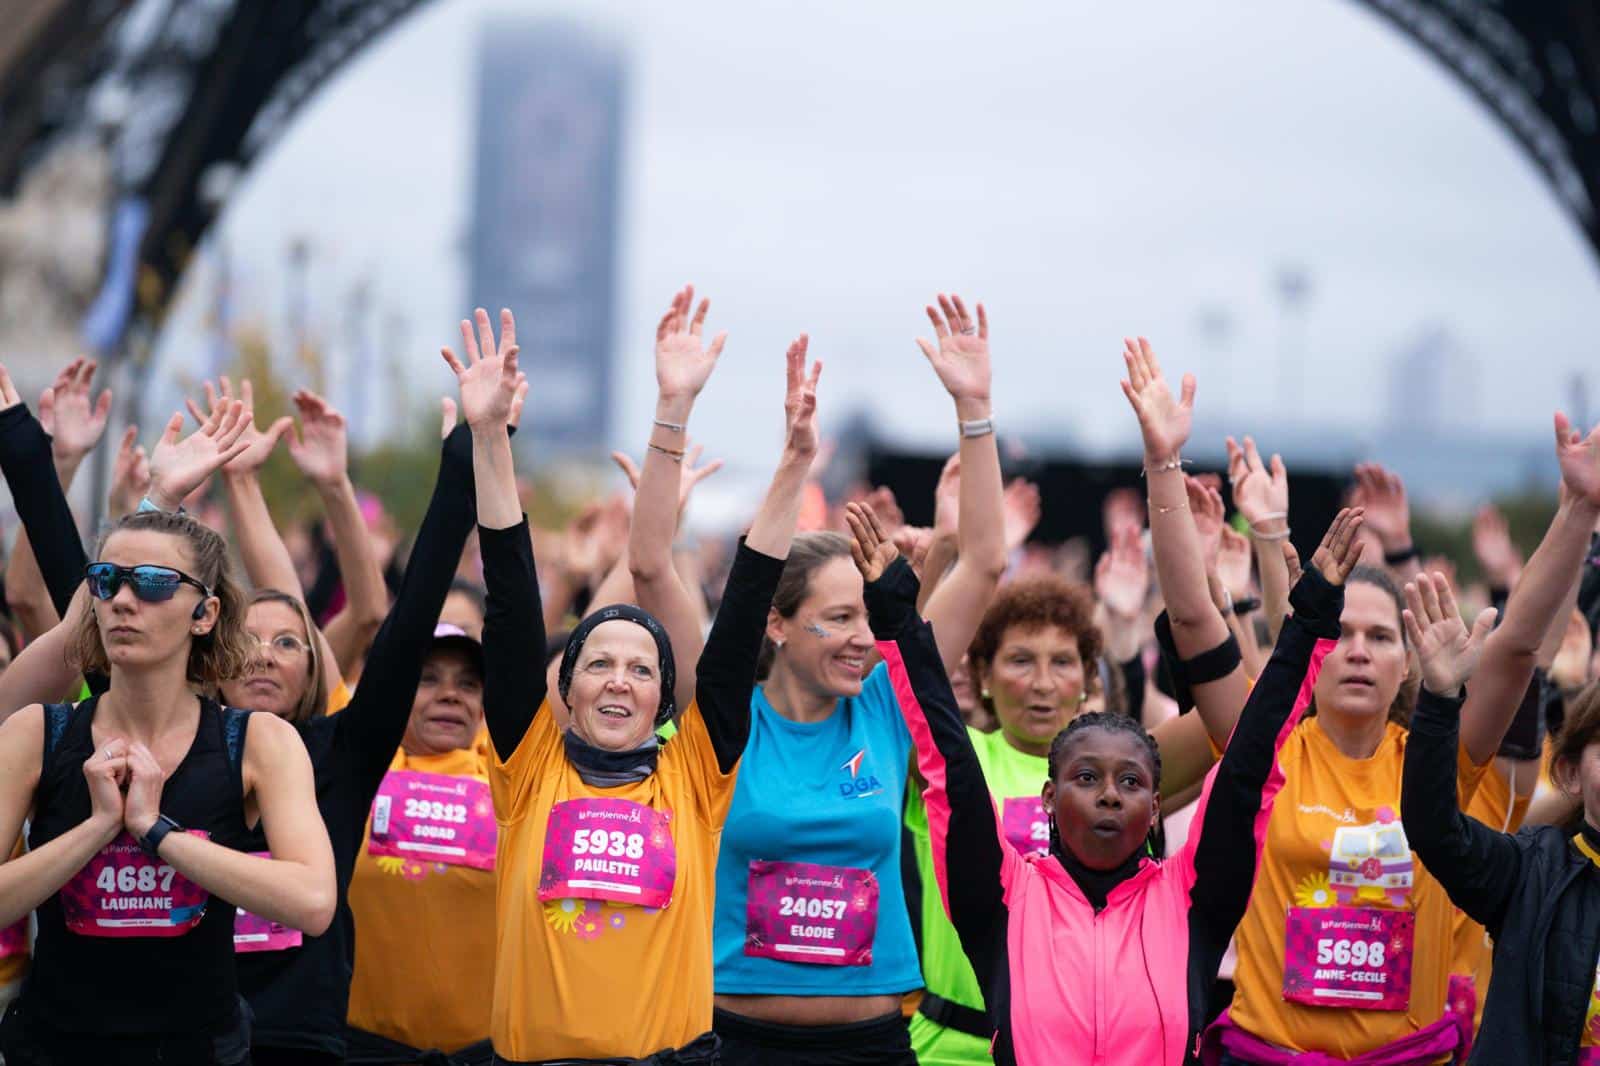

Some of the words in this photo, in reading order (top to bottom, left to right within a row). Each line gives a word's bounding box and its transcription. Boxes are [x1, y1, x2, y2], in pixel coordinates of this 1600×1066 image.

[840, 776, 882, 796] DGA
[404, 798, 467, 824] 29312
[413, 824, 456, 840] SOUAD
[571, 828, 644, 859] 5938
[574, 858, 640, 877] PAULETTE
[96, 865, 176, 893] 4687
[101, 897, 173, 910] LAURIANE
[779, 896, 847, 920] 24057
[790, 925, 835, 939] ELODIE
[1316, 939, 1385, 967] 5698
[1314, 968, 1387, 983] ANNE-CECILE
